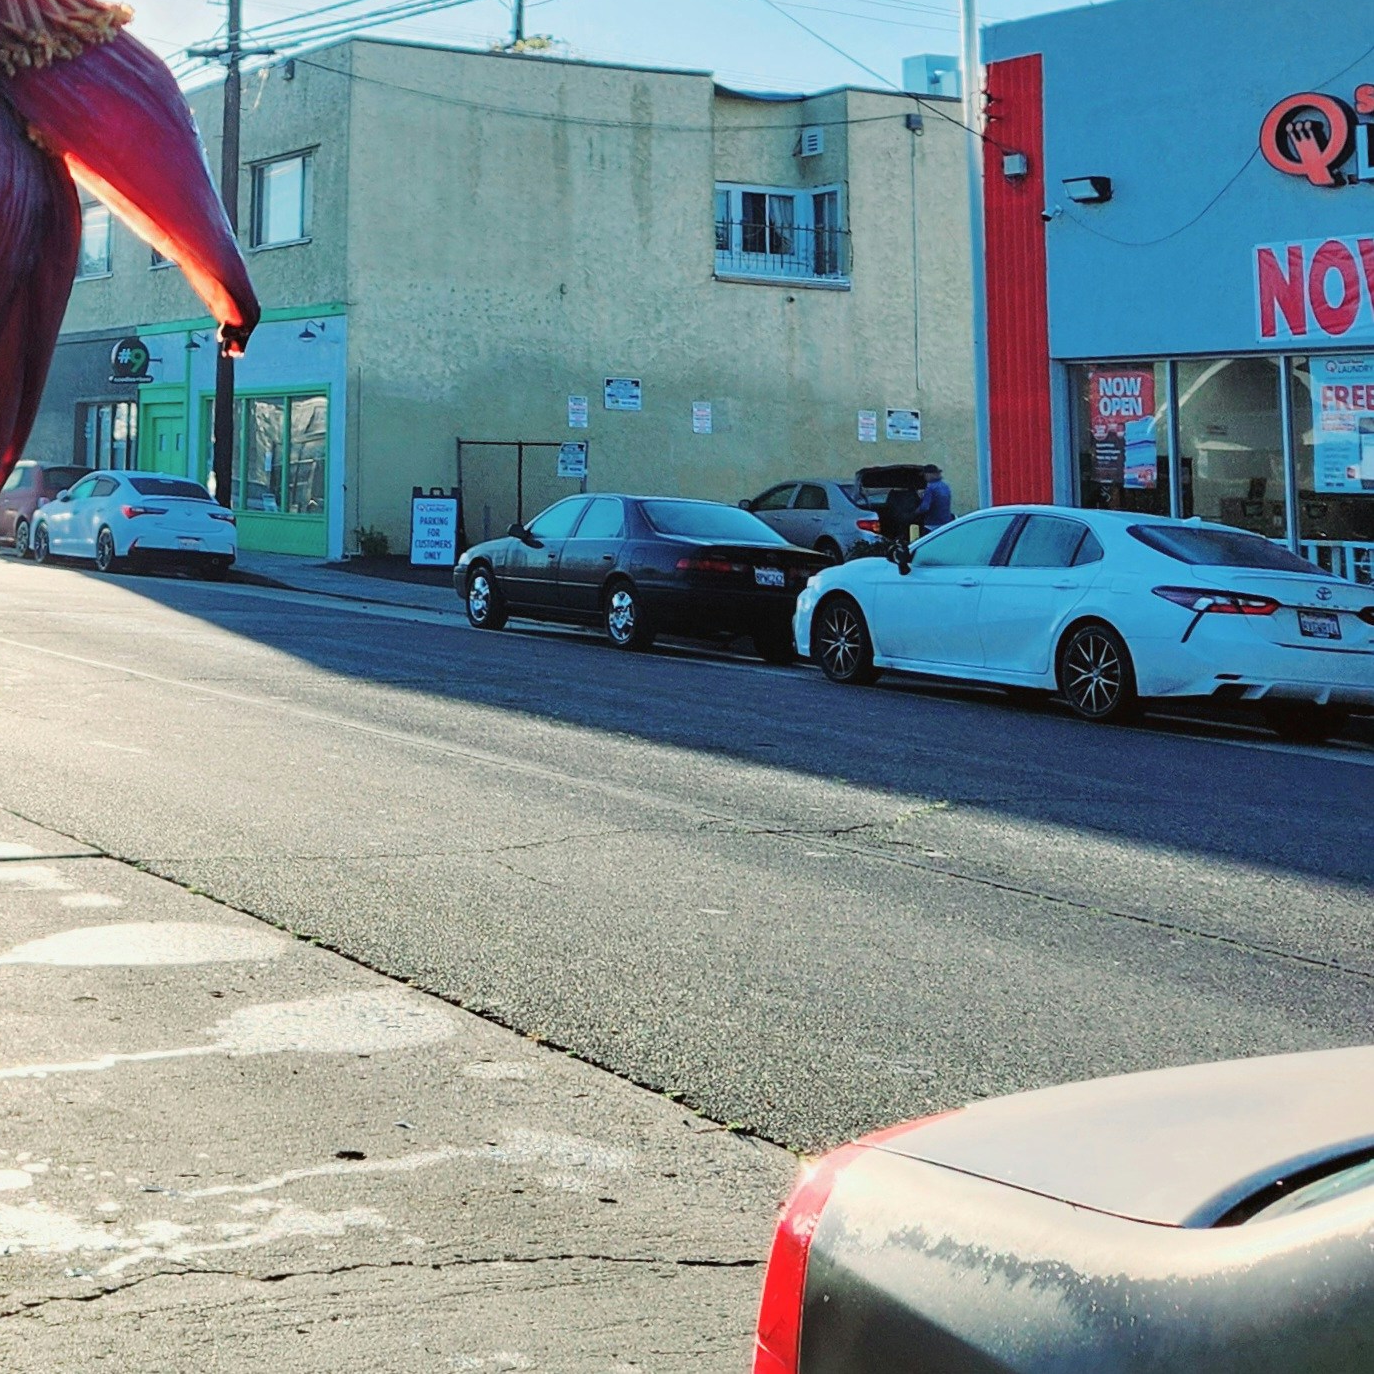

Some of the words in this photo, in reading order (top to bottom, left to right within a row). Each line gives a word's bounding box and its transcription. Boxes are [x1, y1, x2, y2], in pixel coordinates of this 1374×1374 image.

[118, 347, 146, 373] #9
[1099, 377, 1141, 396] NOW
[1099, 397, 1142, 416] OPEN
[420, 516, 448, 525] PARKING
[427, 528, 440, 537] FOR
[415, 539, 452, 549] CUSTOMERS
[424, 551, 441, 560] ONLY
